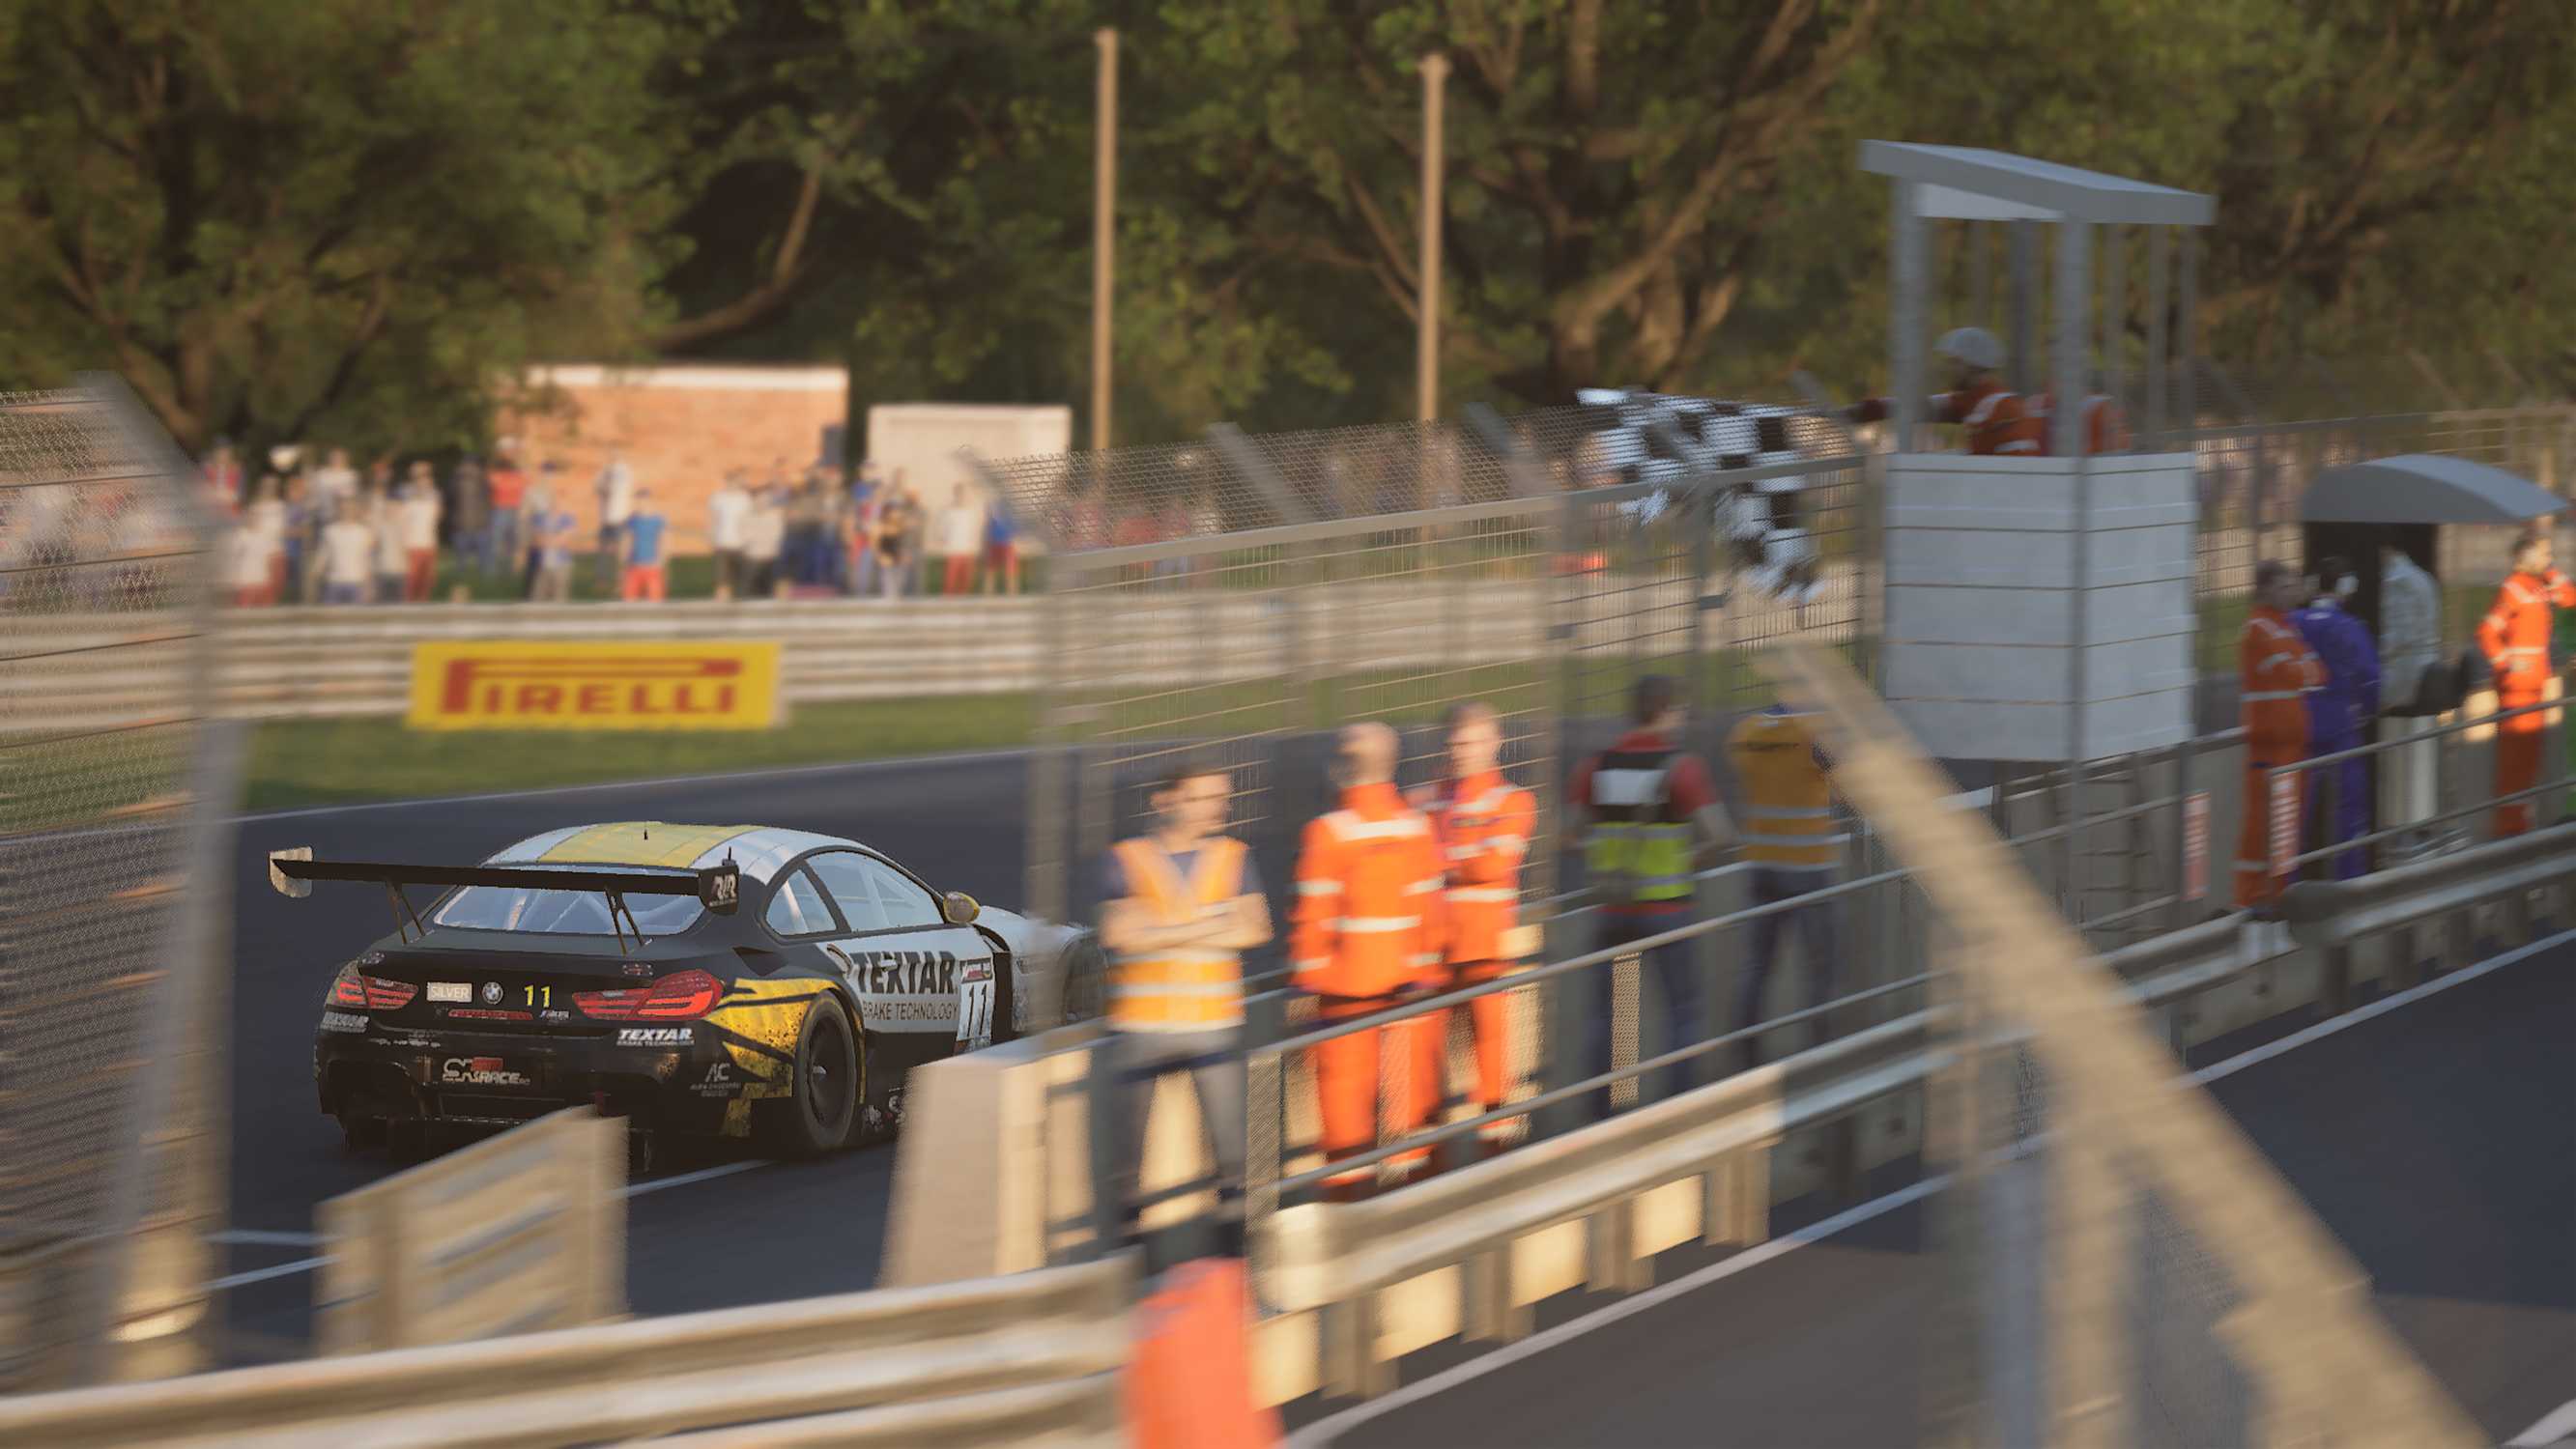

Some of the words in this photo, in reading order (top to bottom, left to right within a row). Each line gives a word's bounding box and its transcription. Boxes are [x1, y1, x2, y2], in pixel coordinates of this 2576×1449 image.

[441, 658, 743, 715] PIRELLI
[848, 951, 957, 994] TEXTAR
[431, 985, 470, 1000] SILVER
[525, 984, 551, 1008] 11
[863, 1001, 892, 1020] BRAKE
[896, 1001, 959, 1020] TECHNOLOGY
[967, 983, 987, 1037] 11
[618, 1028, 694, 1041] TEXTAR
